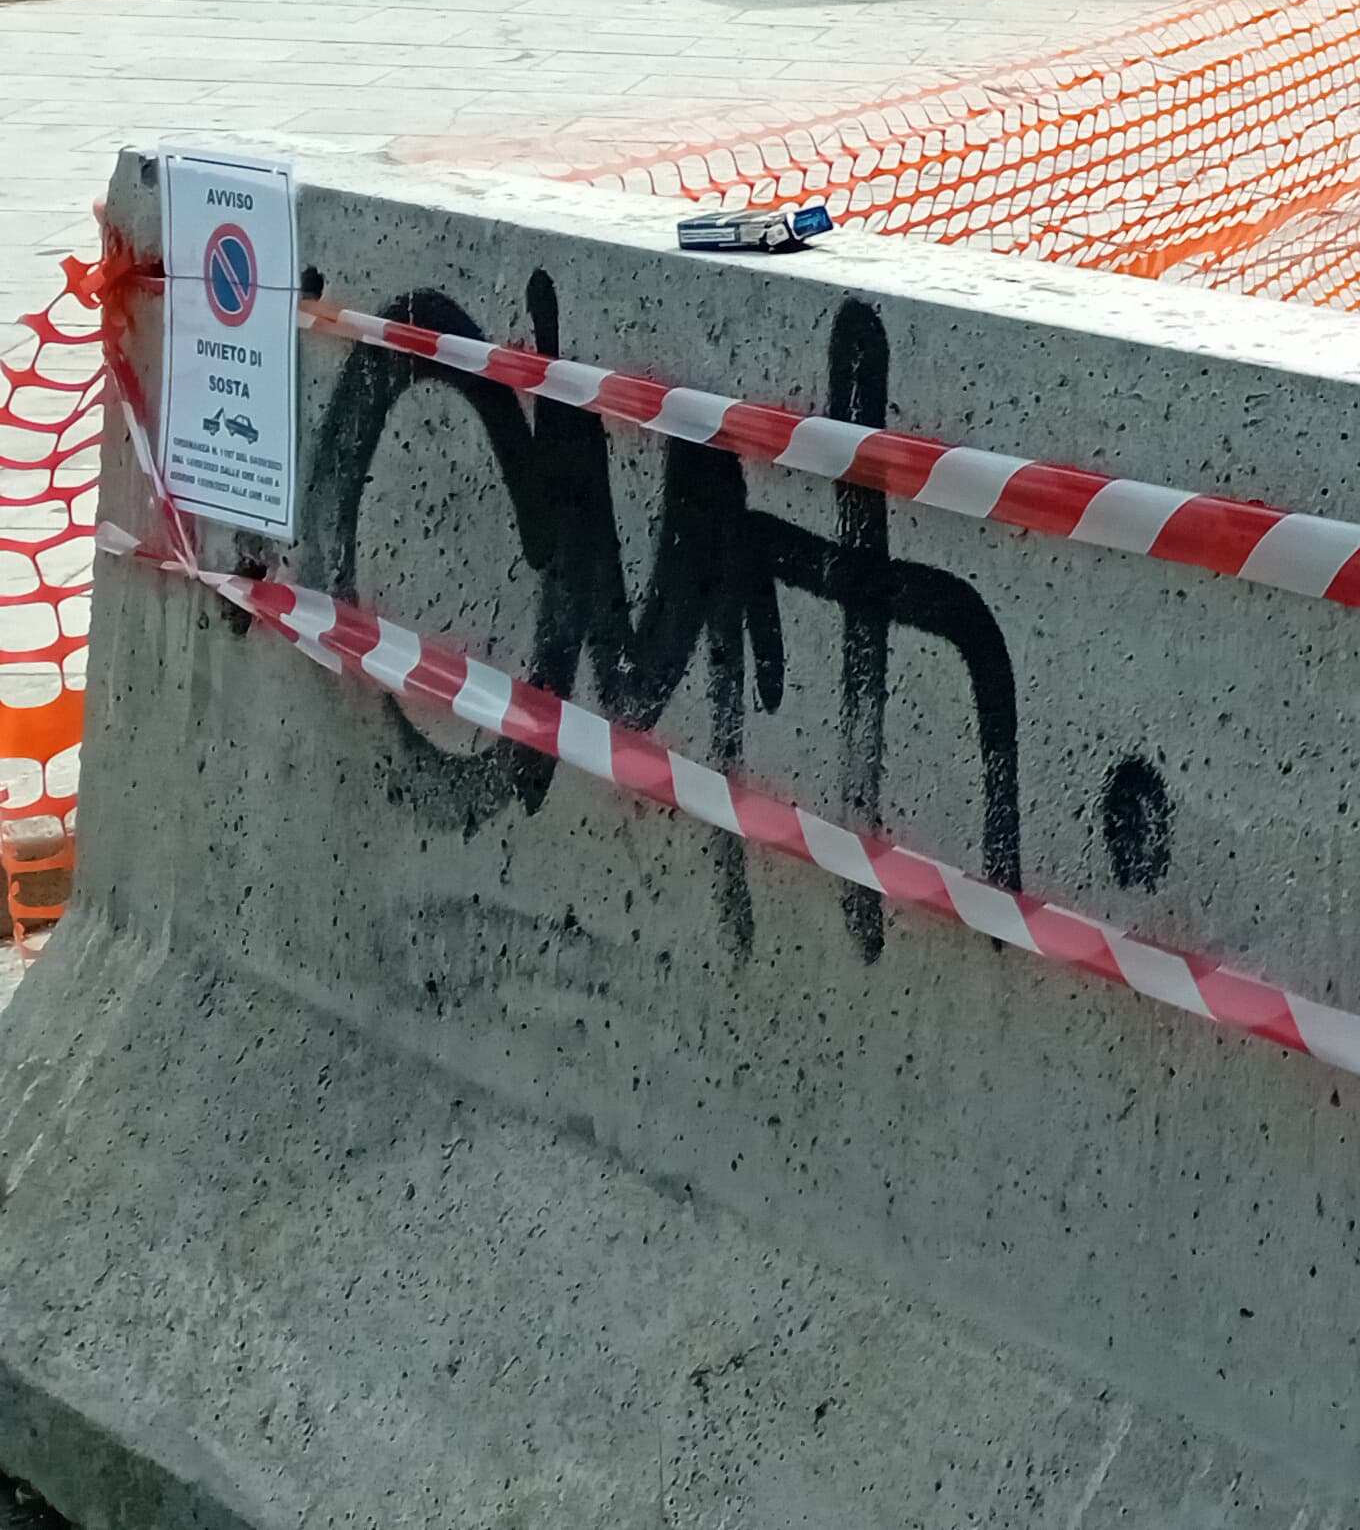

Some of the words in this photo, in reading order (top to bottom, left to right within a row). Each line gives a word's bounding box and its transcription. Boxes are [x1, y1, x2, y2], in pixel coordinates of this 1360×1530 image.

[206, 188, 254, 211] AVVISO
[196, 338, 247, 365] DIVIETO
[249, 346, 263, 368] DI
[208, 374, 251, 400] SOSTA
